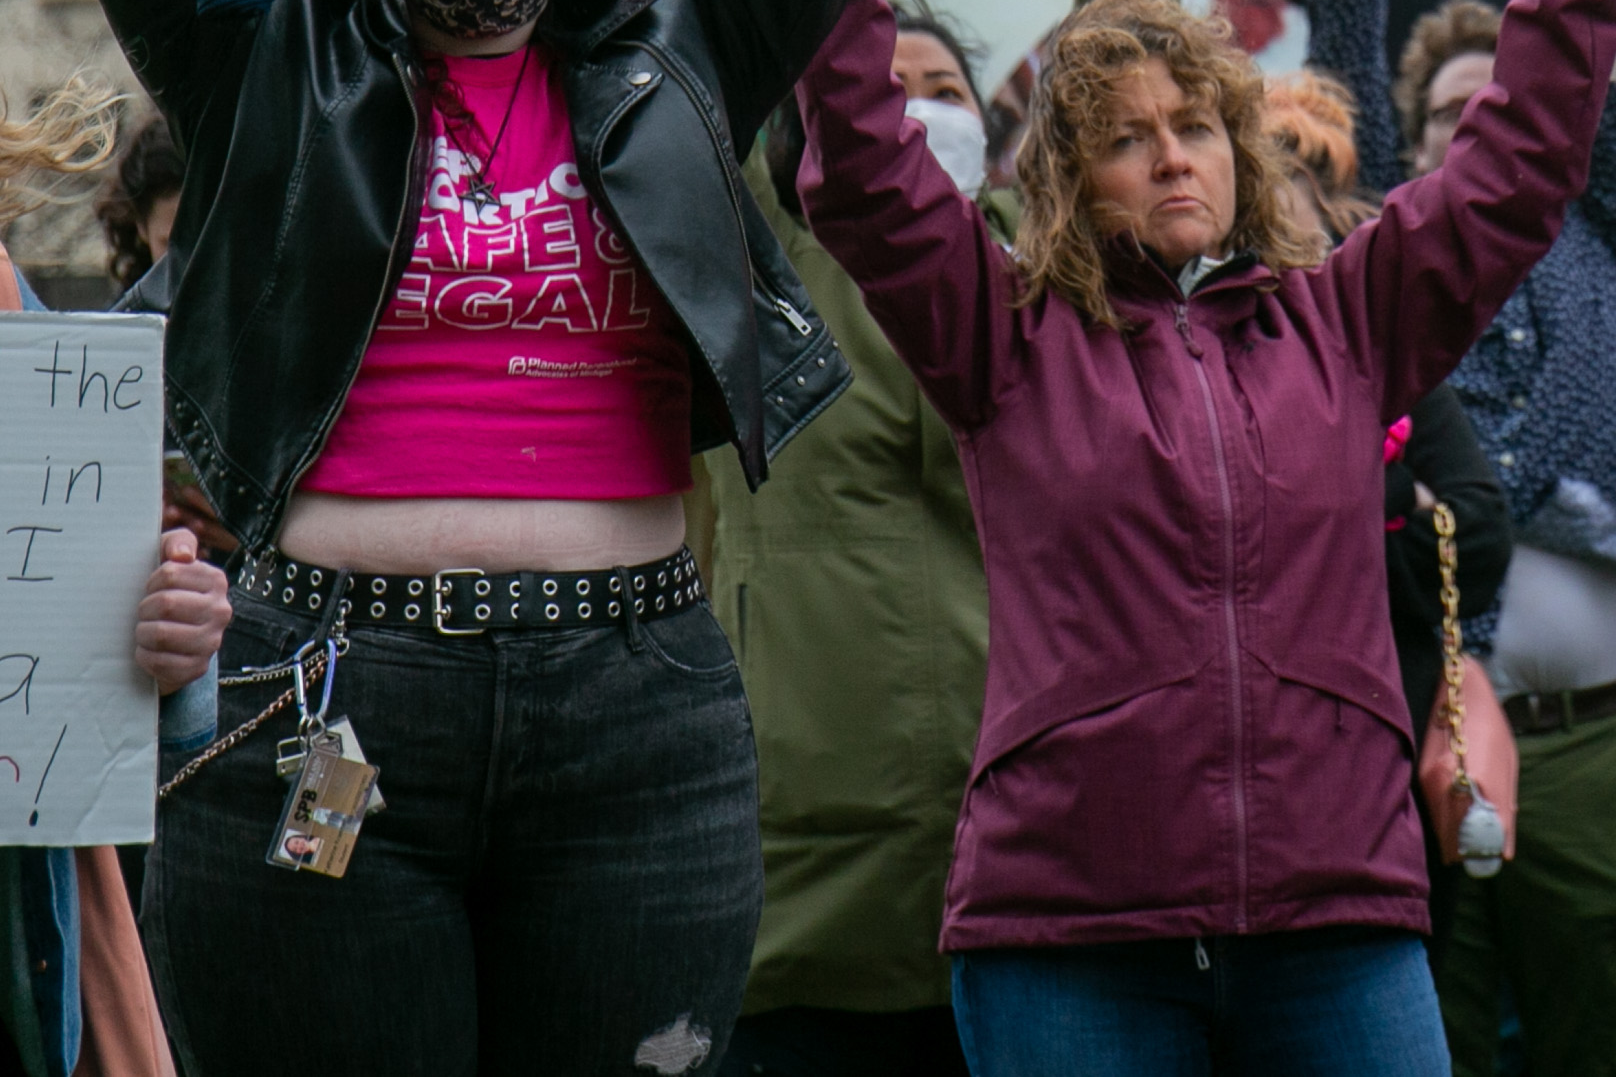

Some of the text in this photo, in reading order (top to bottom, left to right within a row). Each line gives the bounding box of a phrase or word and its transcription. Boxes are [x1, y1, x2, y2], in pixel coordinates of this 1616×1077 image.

[410, 204, 581, 273] AFE
[376, 269, 650, 333] EGAL
[34, 340, 143, 413] the
[528, 357, 577, 370] Planned
[41, 455, 102, 505] in
[7, 526, 63, 582] I
